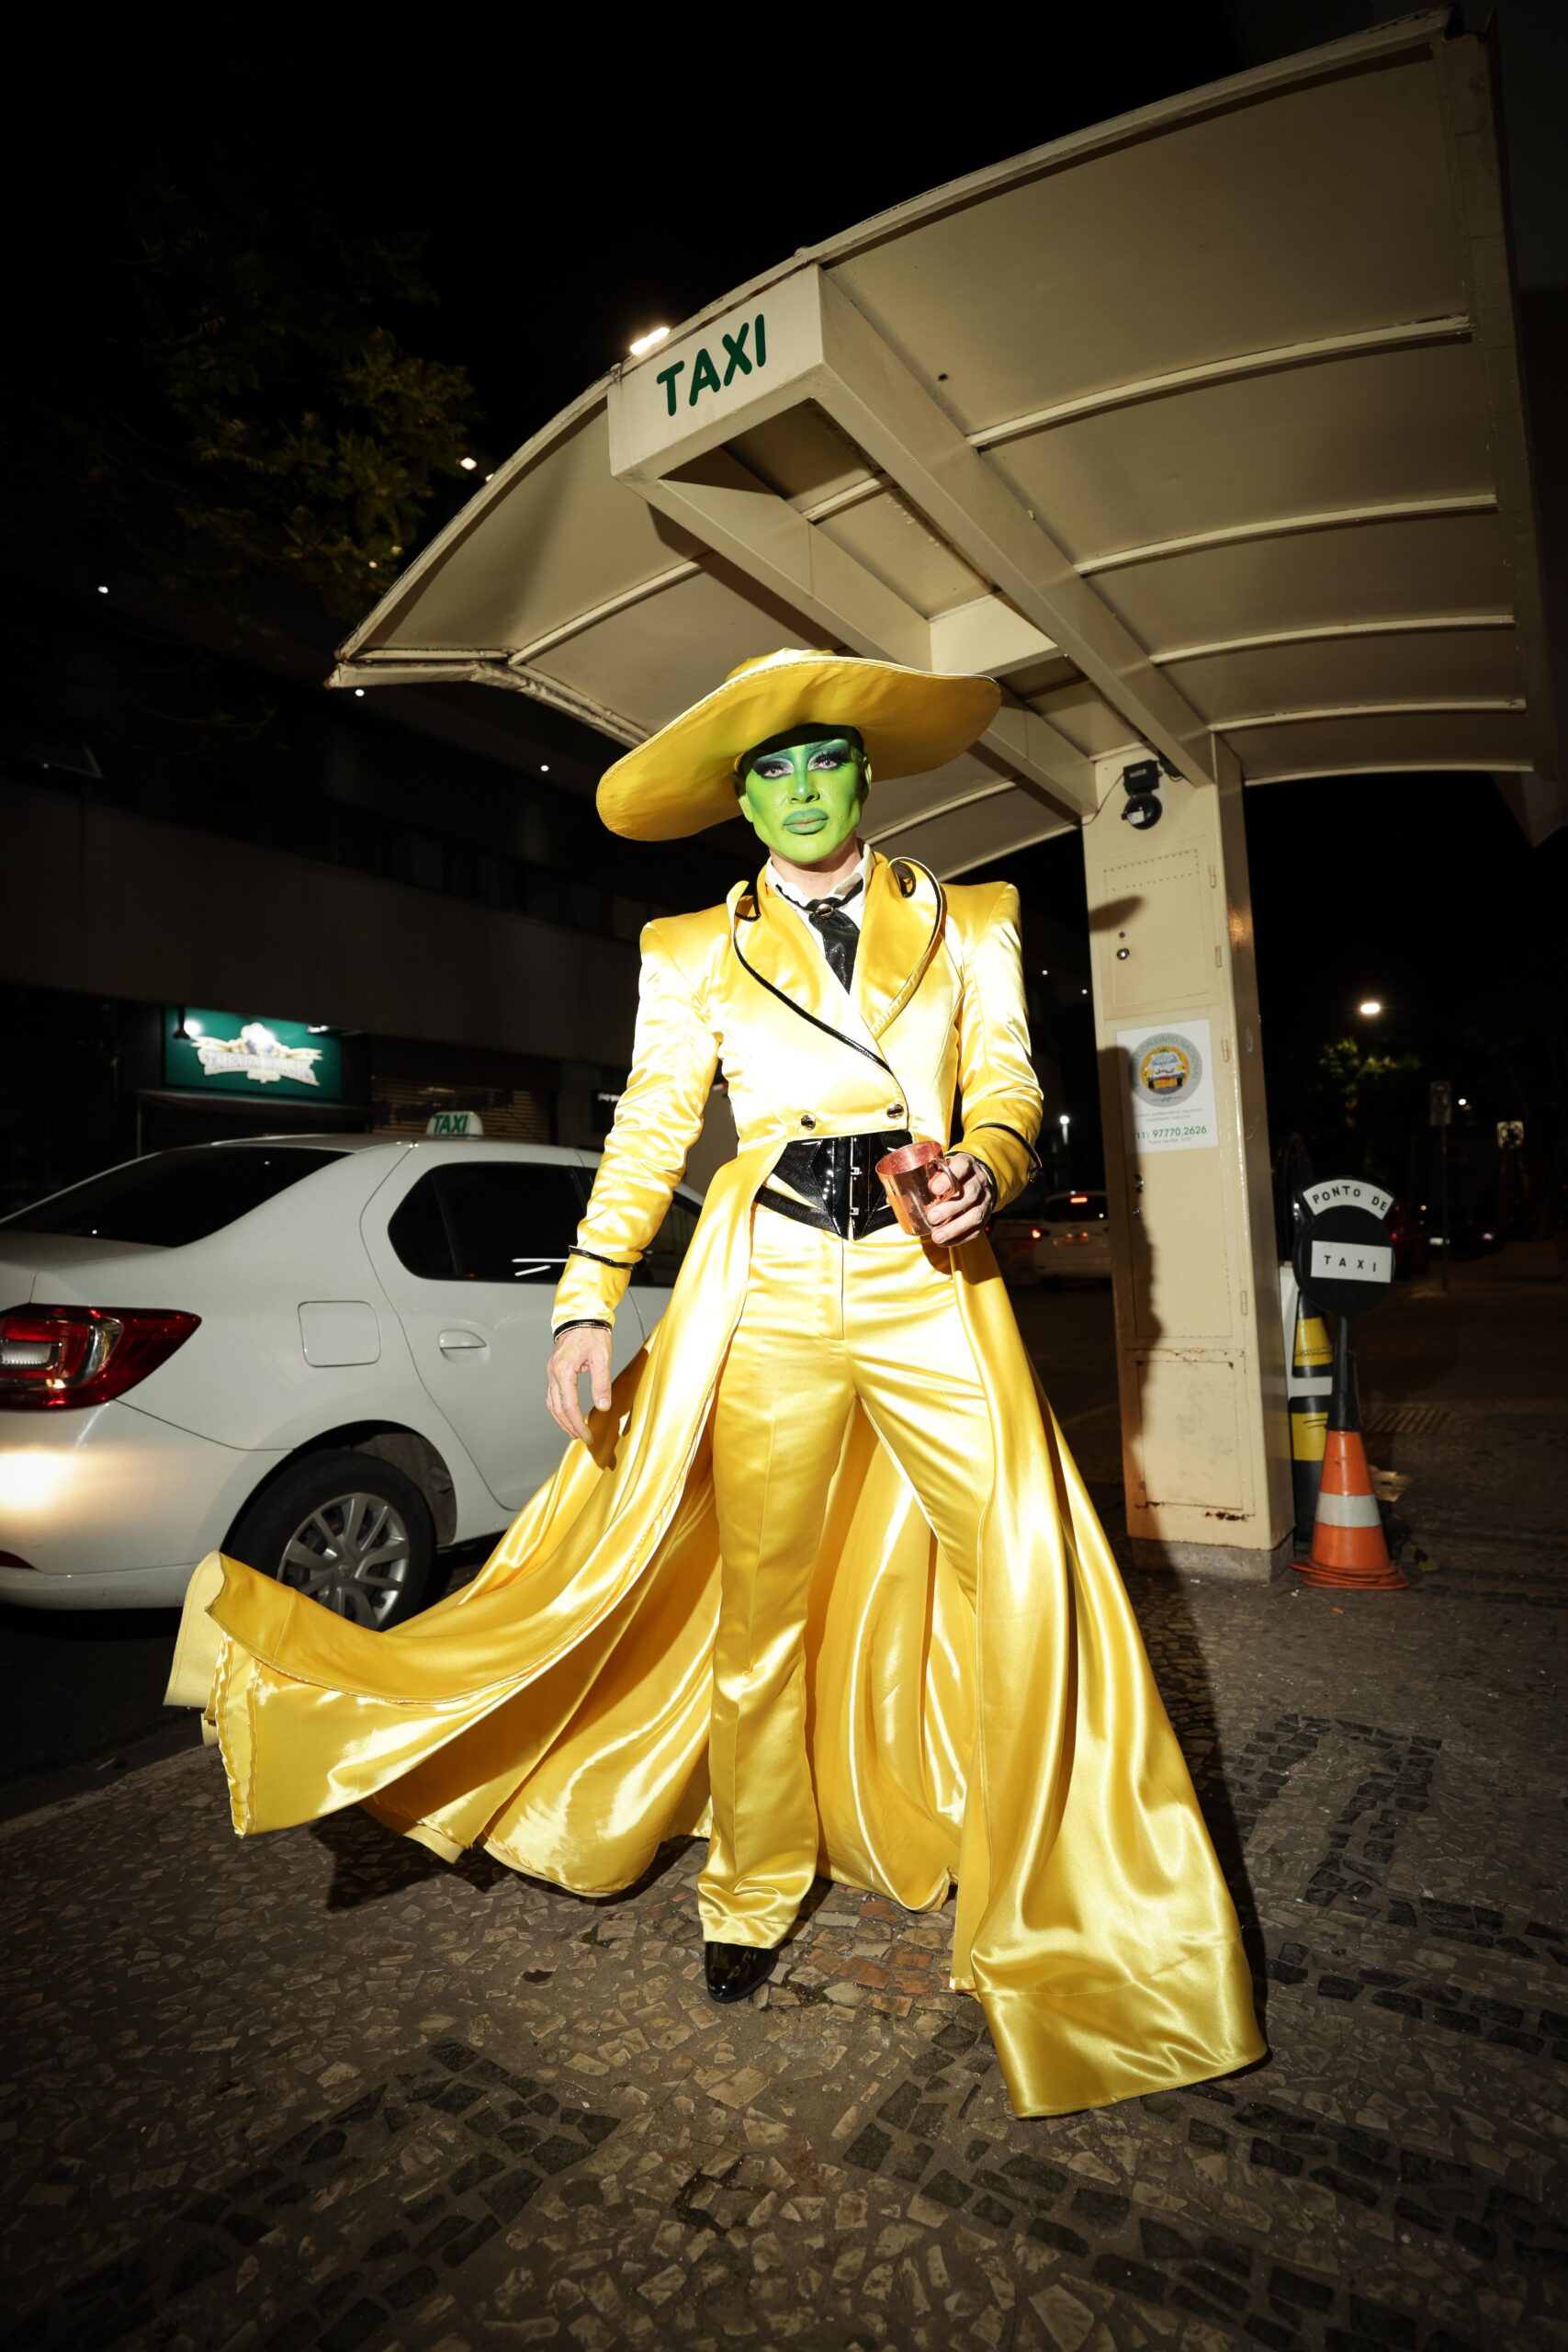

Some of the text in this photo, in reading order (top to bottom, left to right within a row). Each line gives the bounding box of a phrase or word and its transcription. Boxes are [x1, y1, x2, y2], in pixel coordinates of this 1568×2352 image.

[656, 313, 766, 416] TAXI
[433, 1114, 468, 1134] TAXI
[1152, 1125, 1207, 1138] 97770.2626
[1312, 1185, 1388, 1212] PONTO DE
[1324, 1255, 1376, 1272] TAXI
